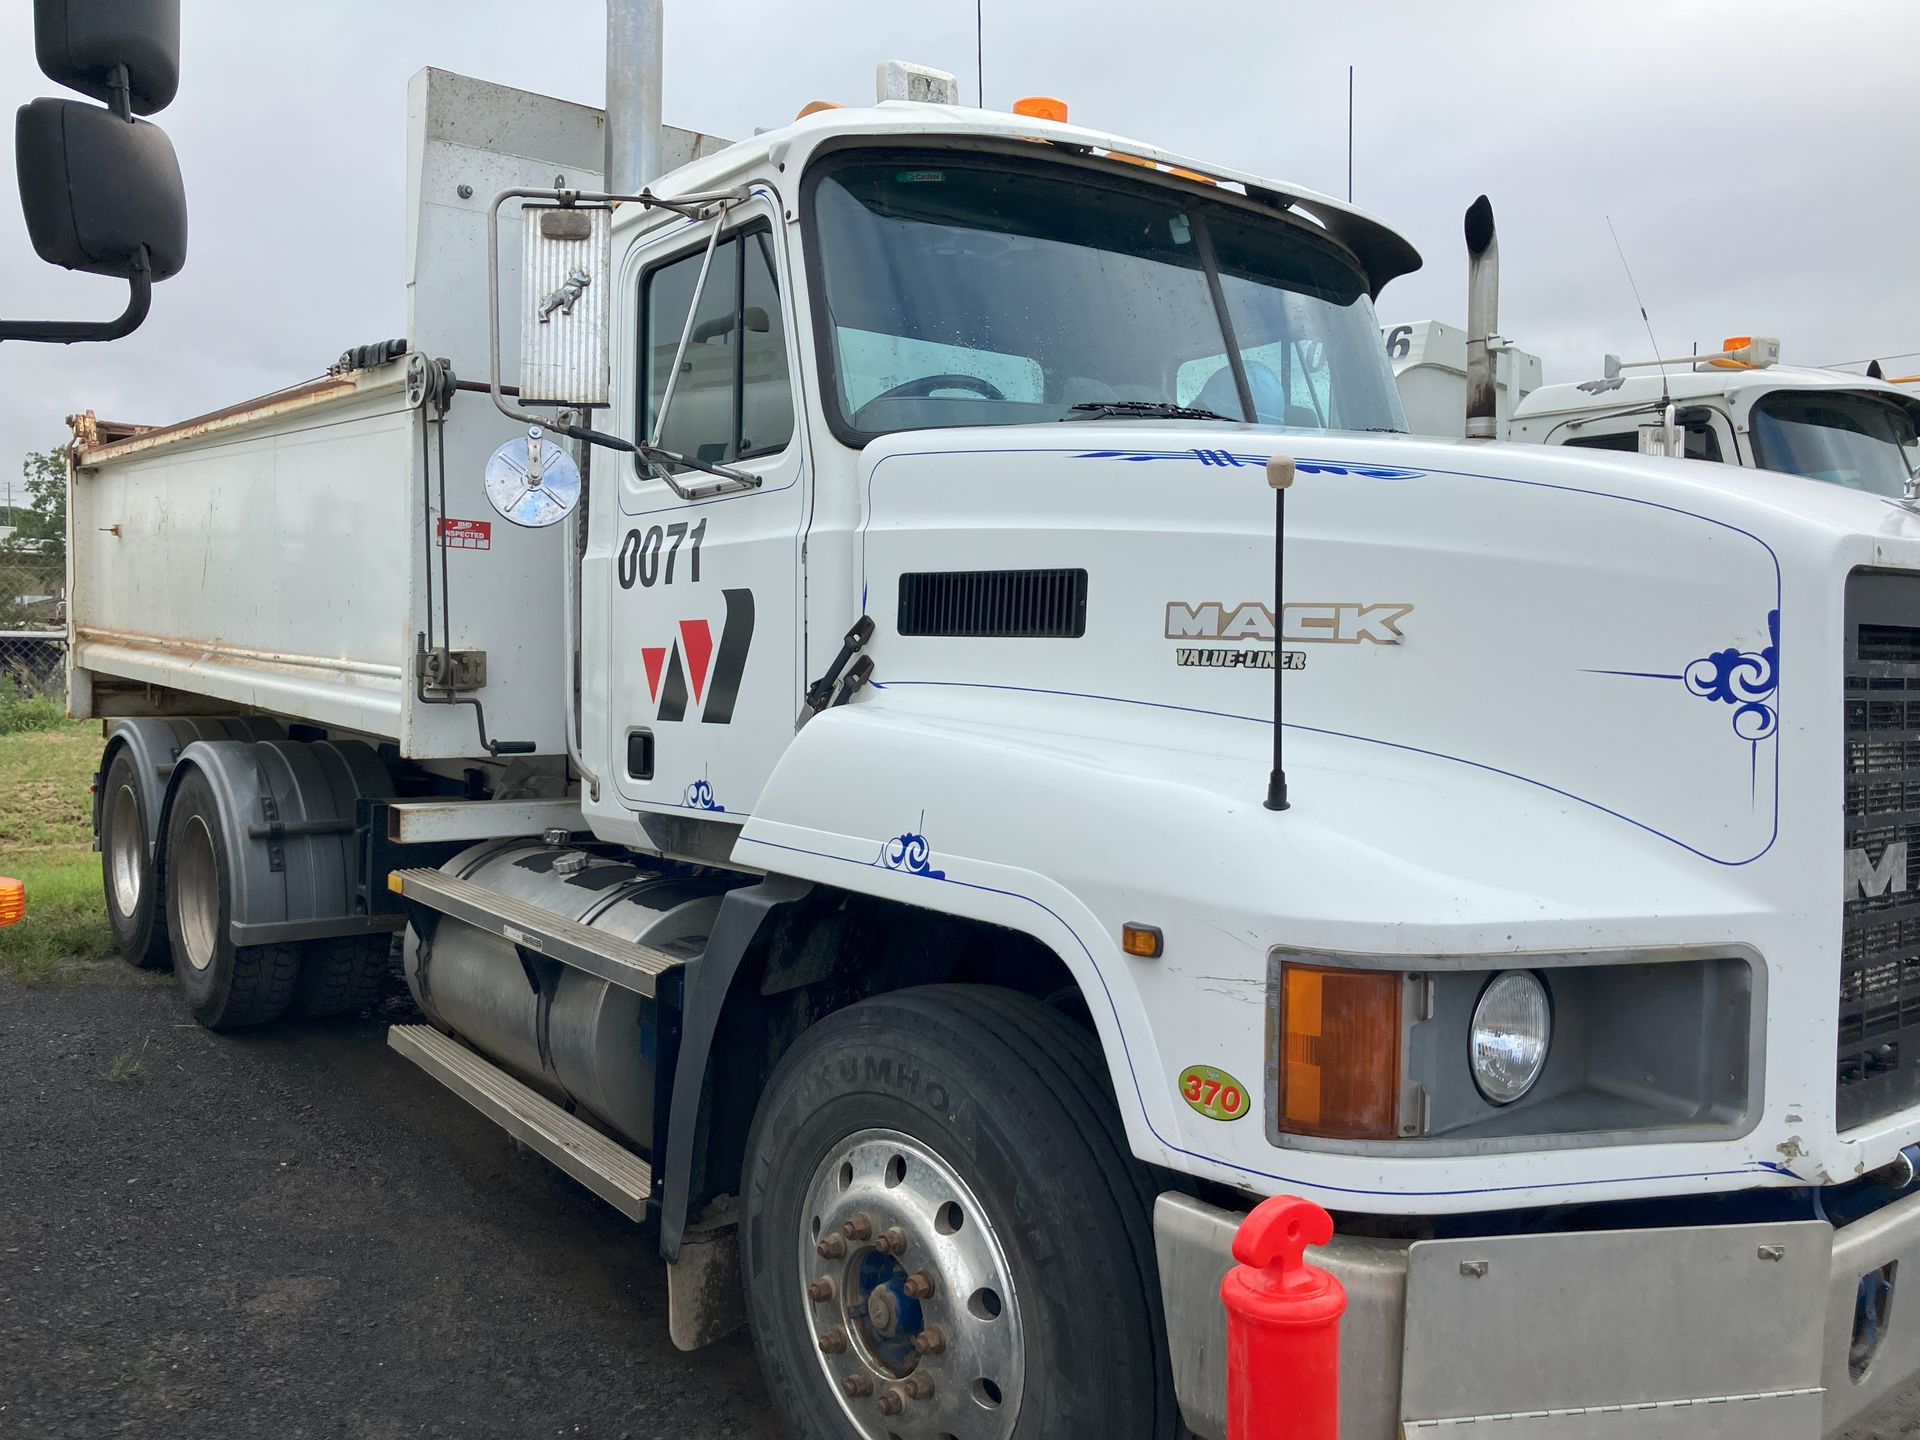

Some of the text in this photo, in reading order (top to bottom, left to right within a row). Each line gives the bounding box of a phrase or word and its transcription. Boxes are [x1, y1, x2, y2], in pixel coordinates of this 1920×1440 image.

[1381, 326, 1413, 360] 6
[444, 530, 485, 539] NSPECTED
[617, 518, 708, 589] 0071
[1165, 602, 1415, 646] MACK
[1844, 841, 1908, 903] M
[814, 1056, 950, 1112] KUMHO
[1183, 1074, 1242, 1115] 370
